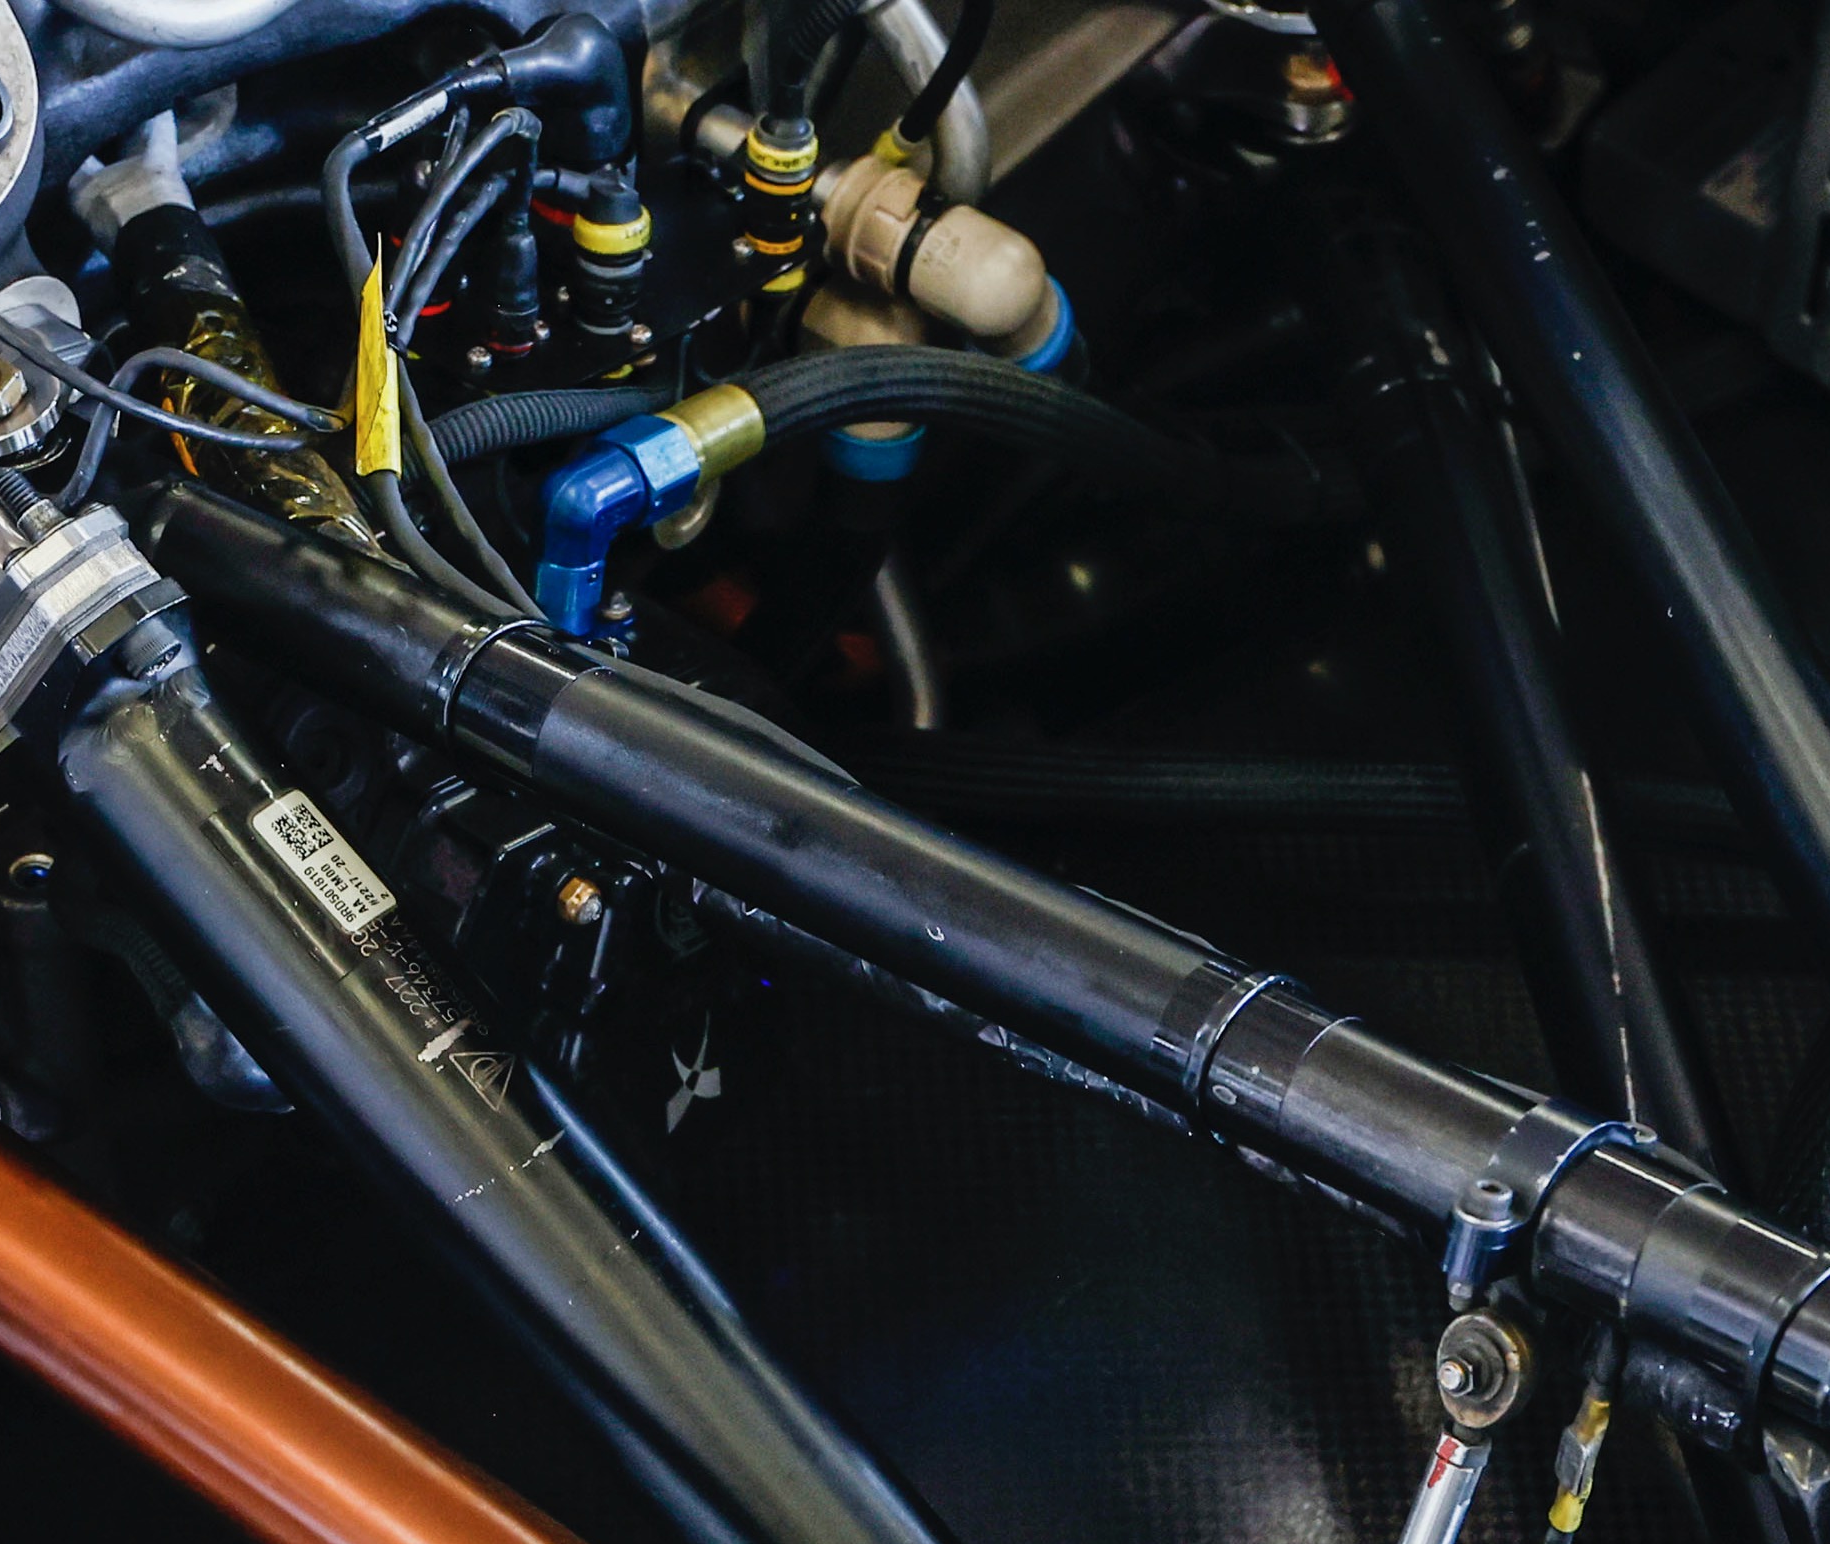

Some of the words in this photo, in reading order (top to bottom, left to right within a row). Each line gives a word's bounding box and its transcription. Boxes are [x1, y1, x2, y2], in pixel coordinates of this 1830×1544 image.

[303, 866, 357, 923] 9RD501819
[320, 863, 349, 892] EM00
[352, 898, 370, 914] AA
[385, 976, 429, 1015] 2217
